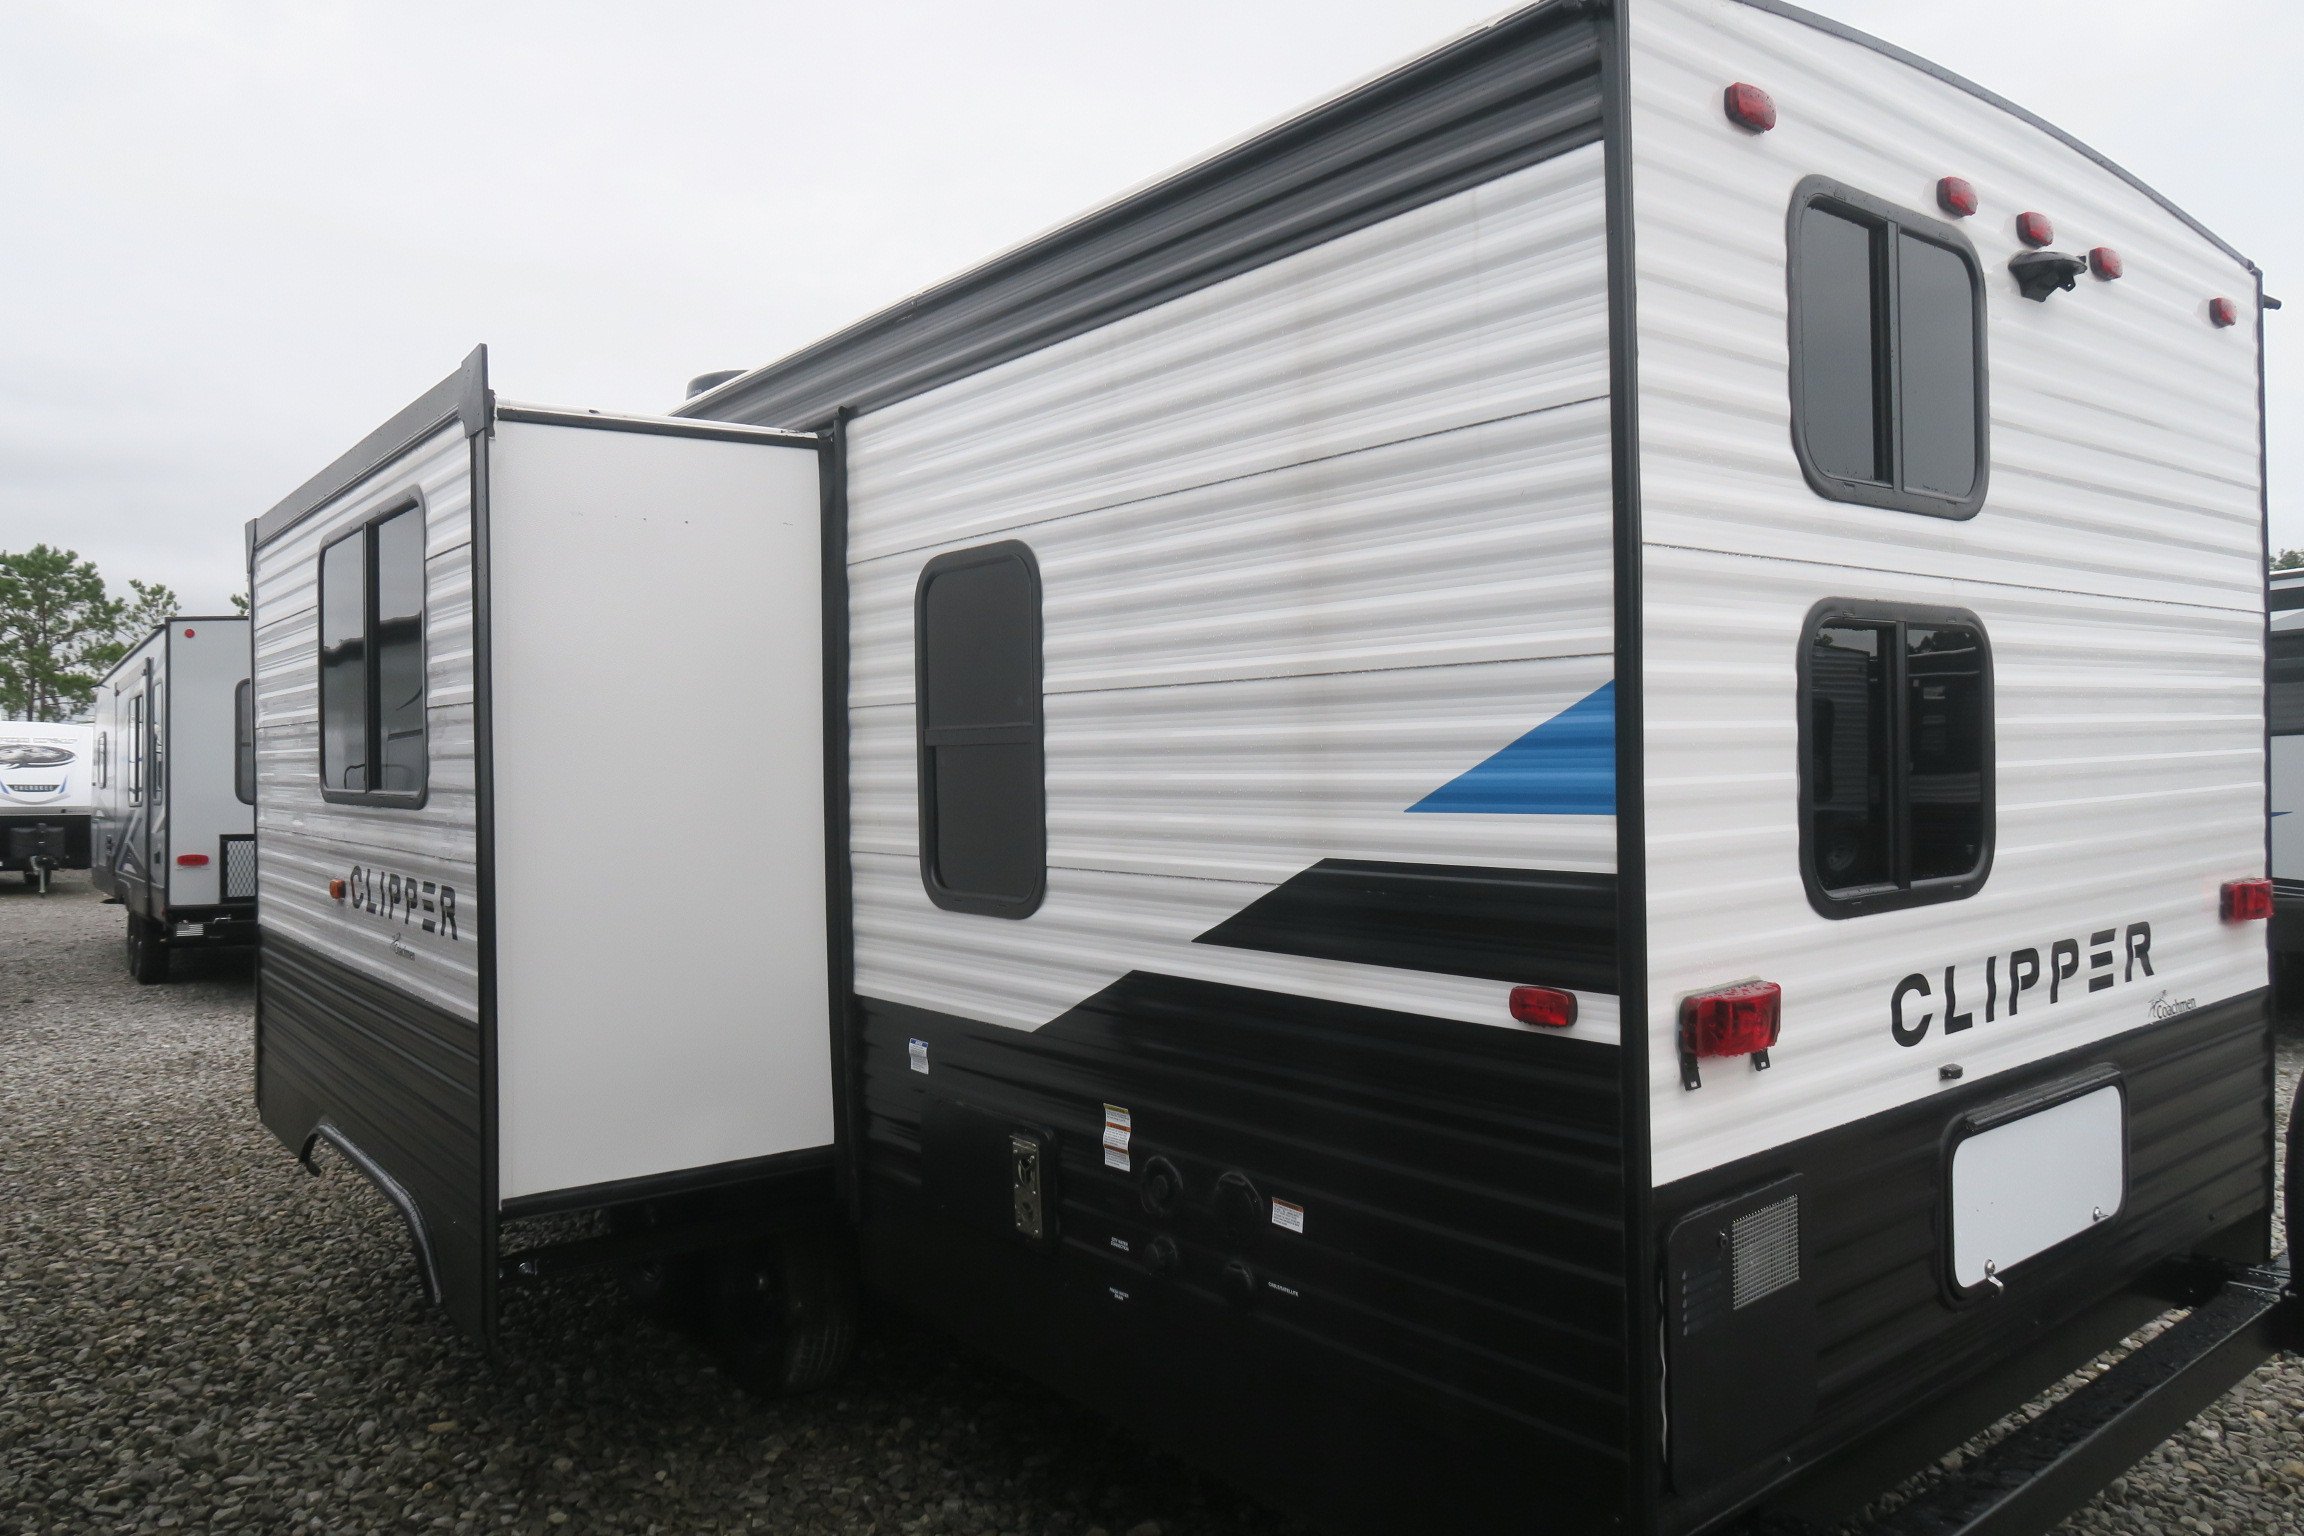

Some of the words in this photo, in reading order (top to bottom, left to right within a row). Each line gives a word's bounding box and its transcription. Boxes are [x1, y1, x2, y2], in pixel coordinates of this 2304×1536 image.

[350, 865, 458, 940] CLIPPER
[1890, 921, 2154, 1047] CLIPPER
[2156, 998, 2196, 1019] Coachmen
